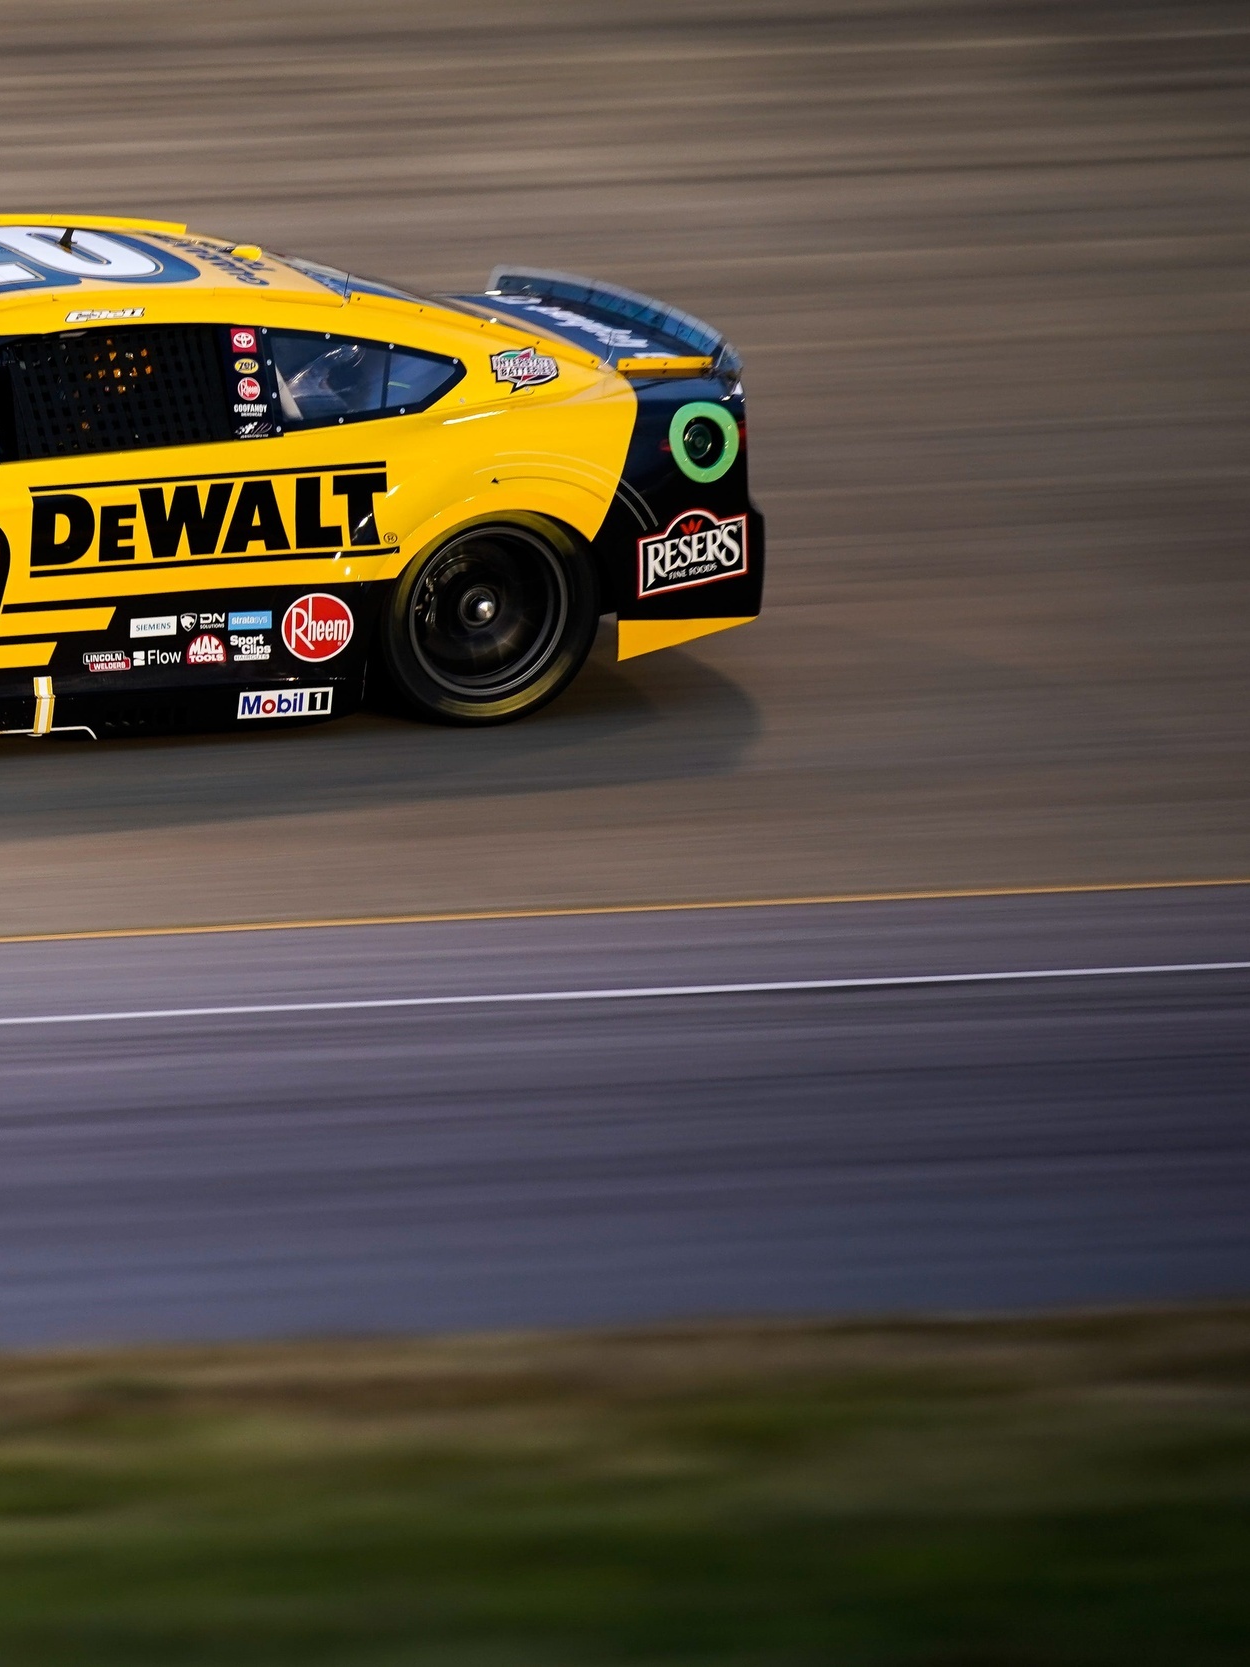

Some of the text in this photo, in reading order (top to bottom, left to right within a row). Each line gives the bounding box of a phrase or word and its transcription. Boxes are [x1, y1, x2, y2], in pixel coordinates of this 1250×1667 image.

[234, 404, 267, 413] COOFANDY
[669, 569, 687, 580] FINE
[199, 612, 225, 624] DN
[231, 615, 268, 625] stratasys
[291, 596, 348, 650] Rheem
[136, 622, 171, 632] SIEMENS
[189, 635, 223, 655] MAC
[230, 634, 264, 648] Sport
[241, 644, 272, 657] Clips
[85, 653, 122, 663] LINCOLN
[147, 649, 182, 666] Flow
[188, 654, 224, 663] TOOLS
[93, 661, 126, 670] WELDERS
[241, 692, 322, 716] Mobil 1
